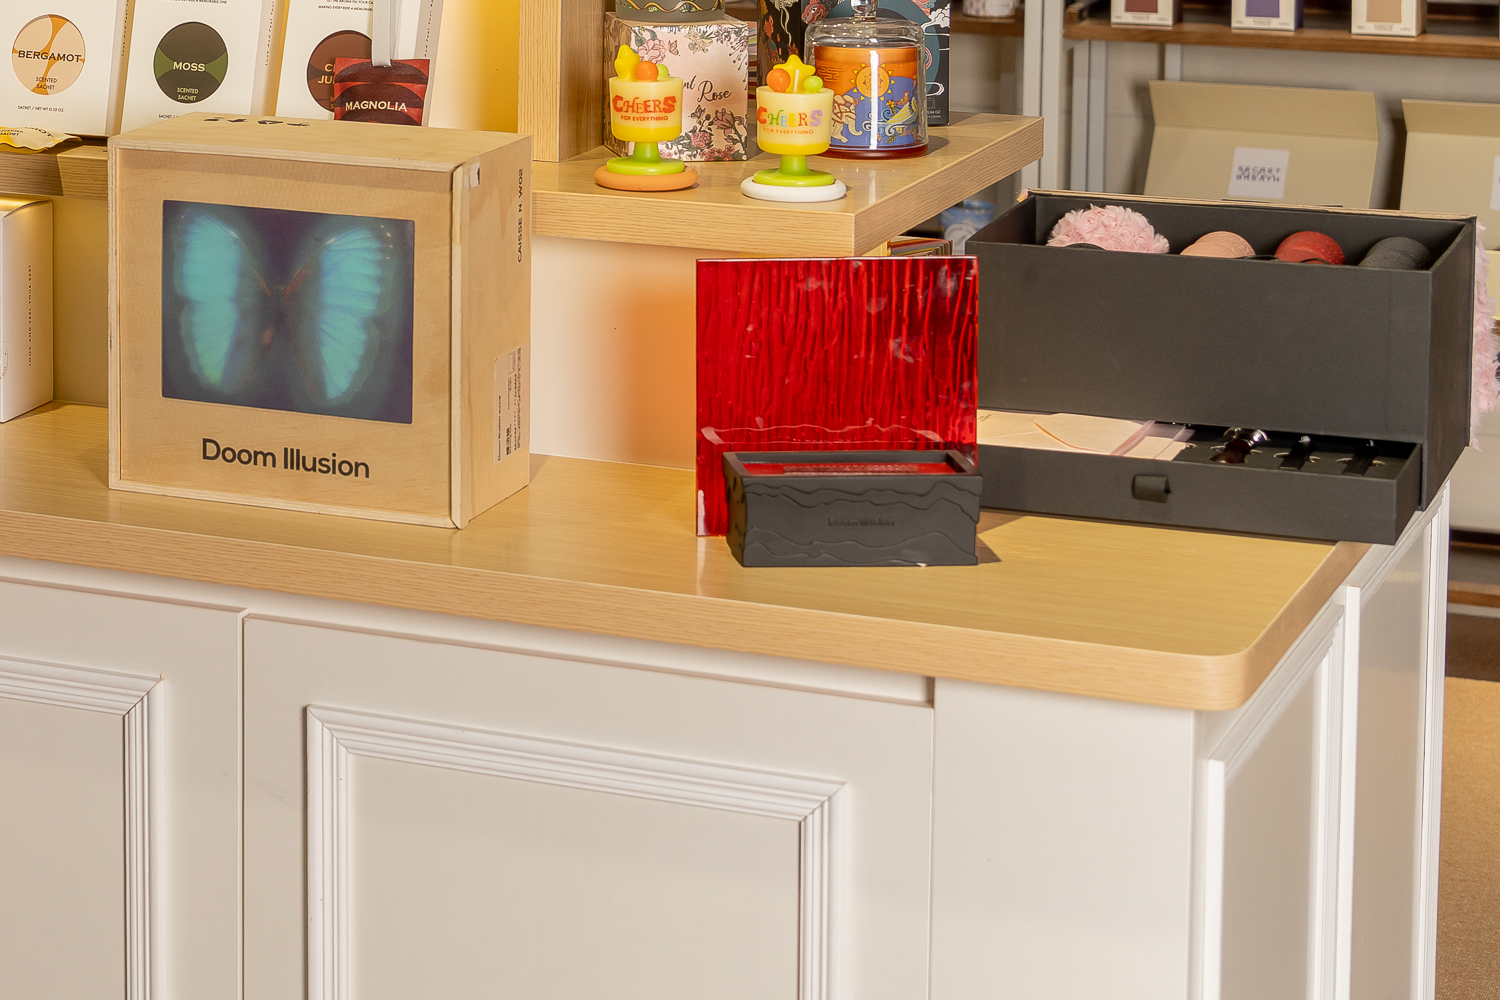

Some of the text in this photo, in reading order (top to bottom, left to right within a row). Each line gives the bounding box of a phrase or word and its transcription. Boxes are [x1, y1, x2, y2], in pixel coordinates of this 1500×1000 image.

[18, 50, 81, 62] BERGAMOT
[173, 62, 205, 71] MOSS
[697, 80, 732, 103] Rose
[346, 101, 407, 111] MAGNOLIA
[612, 95, 676, 113] CHEERS
[757, 106, 823, 127] CHEERS
[203, 438, 369, 478] Doom Illusion
